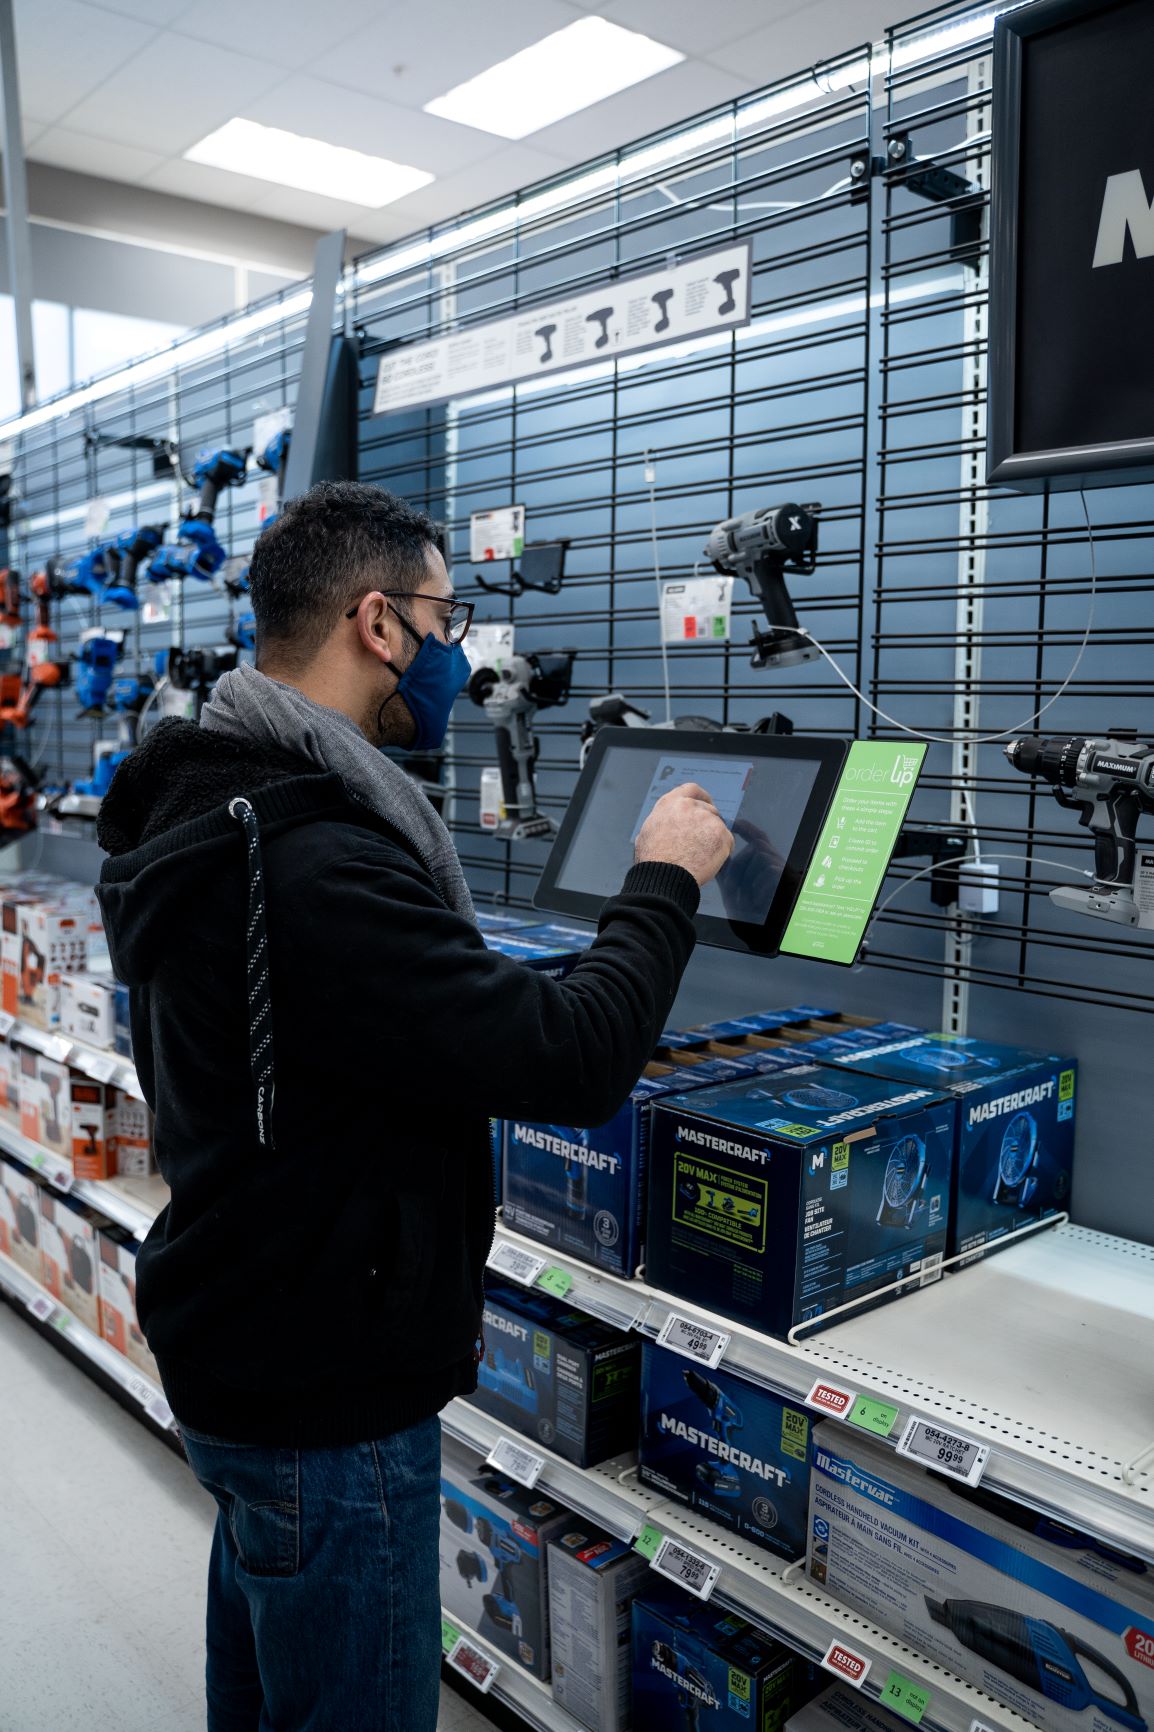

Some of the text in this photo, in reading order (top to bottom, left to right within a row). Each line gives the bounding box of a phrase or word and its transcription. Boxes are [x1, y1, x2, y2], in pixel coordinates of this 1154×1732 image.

[845, 760, 889, 783] order
[816, 1089, 934, 1127] MASTERCRAFT
[970, 1081, 1055, 1125] MASTERCRAFT
[514, 1123, 618, 1175] MASTERCRAFT
[677, 1125, 768, 1165] MASTERCRAFT
[678, 1161, 717, 1183] 20V MAX
[814, 1206, 825, 1215] SITE
[804, 1216, 814, 1225] FAN
[816, 1389, 846, 1405] TESTED
[786, 1411, 804, 1427] 20V
[860, 1406, 867, 1416] 6
[785, 1422, 804, 1436] MAX
[925, 1428, 970, 1452] 054-4273-8
[943, 1441, 966, 1456] RATCHET
[661, 1413, 787, 1487] MASTERCRAFT
[815, 1484, 845, 1506] CORDLESS
[846, 1502, 879, 1526] HANDHELD
[880, 1521, 908, 1541] VACUUM
[908, 1536, 919, 1548] KIT
[815, 1497, 850, 1523] ASPIRATEUR
[850, 1516, 856, 1527] À
[856, 1522, 873, 1537] MAIN
[874, 1531, 892, 1547] SANS
[893, 1542, 902, 1554] FIL
[643, 1534, 652, 1546] 12
[834, 1650, 861, 1672] TESTED
[651, 1657, 721, 1710] MASTERCRAFT
[730, 1670, 747, 1686] 20V
[731, 1680, 747, 1693] MAX
[889, 1684, 902, 1697] 13
[905, 1698, 922, 1712] display
